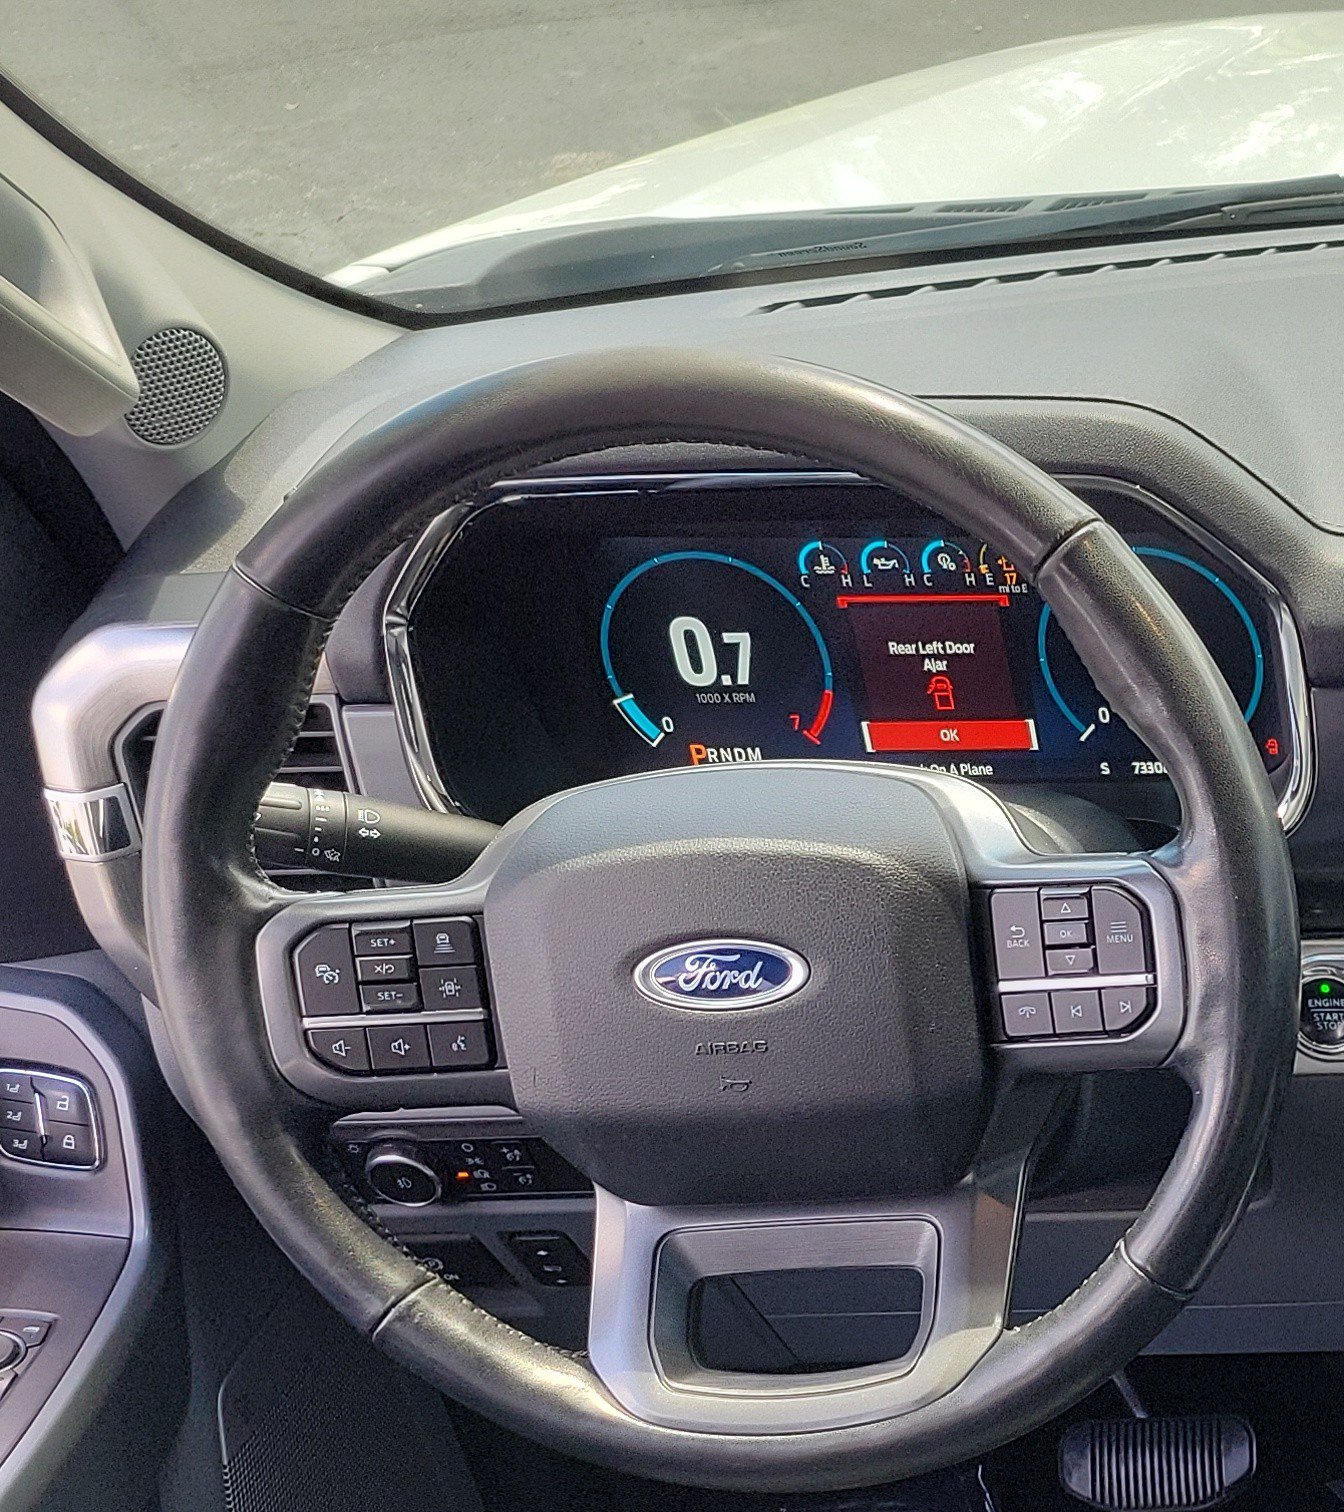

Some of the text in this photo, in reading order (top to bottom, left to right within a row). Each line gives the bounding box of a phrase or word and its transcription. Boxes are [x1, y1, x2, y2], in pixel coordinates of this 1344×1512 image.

[801, 574, 810, 587] C
[841, 574, 852, 587] H
[863, 574, 873, 587] L
[904, 574, 915, 587] H
[923, 573, 933, 587] C
[965, 573, 976, 586] H
[984, 573, 994, 585] E
[1004, 572, 1017, 585] 17
[1011, 584, 1020, 593] to
[669, 616, 751, 687] 0.7
[887, 641, 975, 655] Rear Left Door
[923, 658, 948, 672] Ajar
[695, 692, 721, 704] 1000
[732, 692, 756, 703] RPM
[1098, 707, 1110, 723] 0
[661, 716, 674, 733] 0
[788, 713, 800, 731] 7
[939, 729, 960, 742] OK
[960, 762, 994, 776] Plane
[1100, 762, 1110, 775] S
[1059, 929, 1073, 939] OK
[1106, 933, 1134, 944] MENU
[1006, 938, 1030, 949] BACK
[678, 953, 764, 993] Ford
[1313, 1012, 1344, 1022] START
[695, 1040, 769, 1056] AIRBAG
